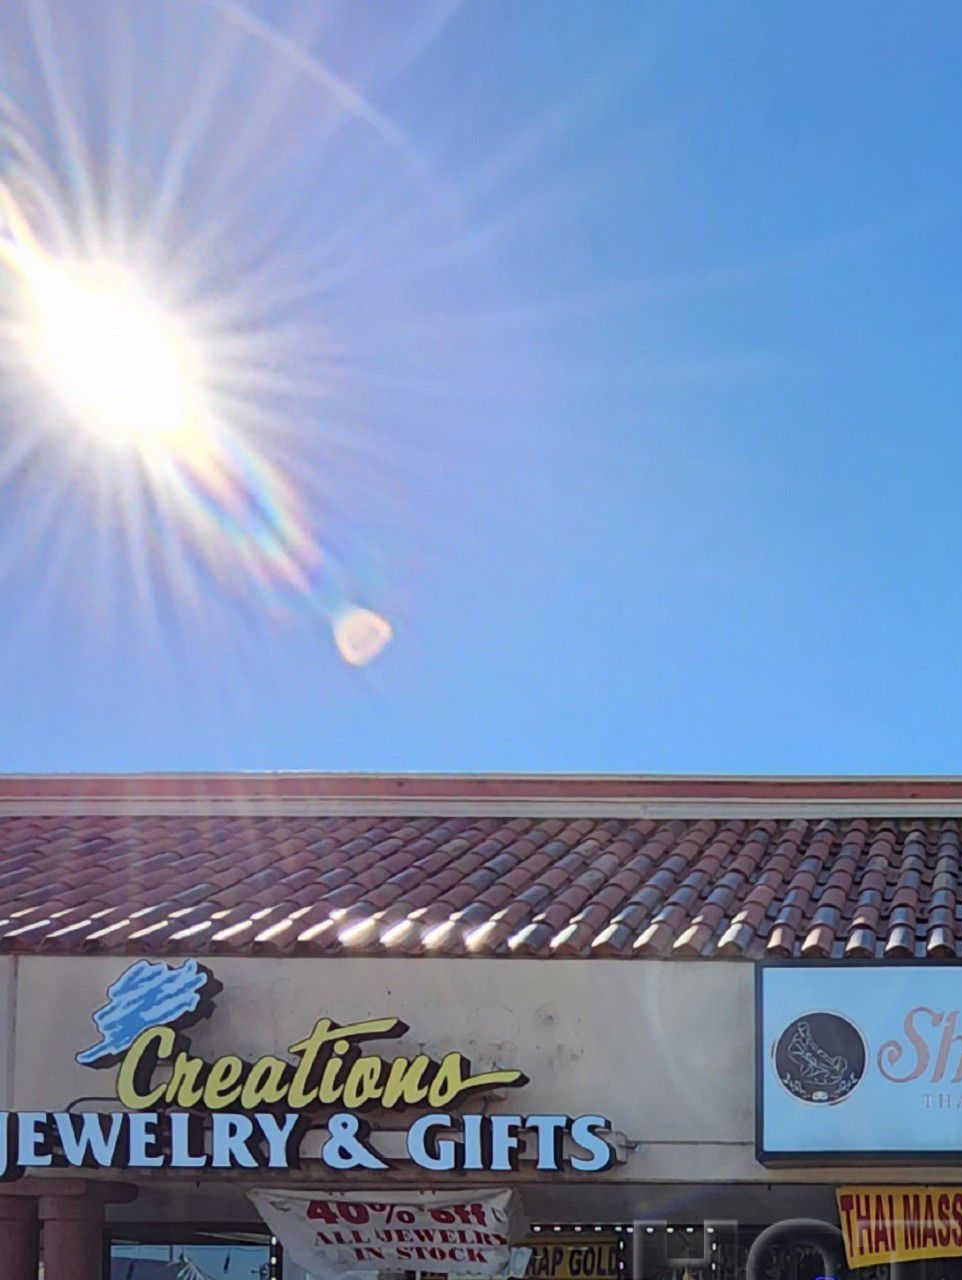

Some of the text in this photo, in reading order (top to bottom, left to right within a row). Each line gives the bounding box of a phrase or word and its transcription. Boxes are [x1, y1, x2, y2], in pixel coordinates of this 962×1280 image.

[116, 1017, 523, 1110] Creations
[322, 1113, 389, 1170] &
[406, 1114, 615, 1171] GIFTS
[316, 1229, 507, 1246] ALL JEWELRY
[840, 1194, 896, 1257] THAI
[353, 1247, 488, 1263] IN STOCK
[570, 1247, 618, 1276] GOLD
